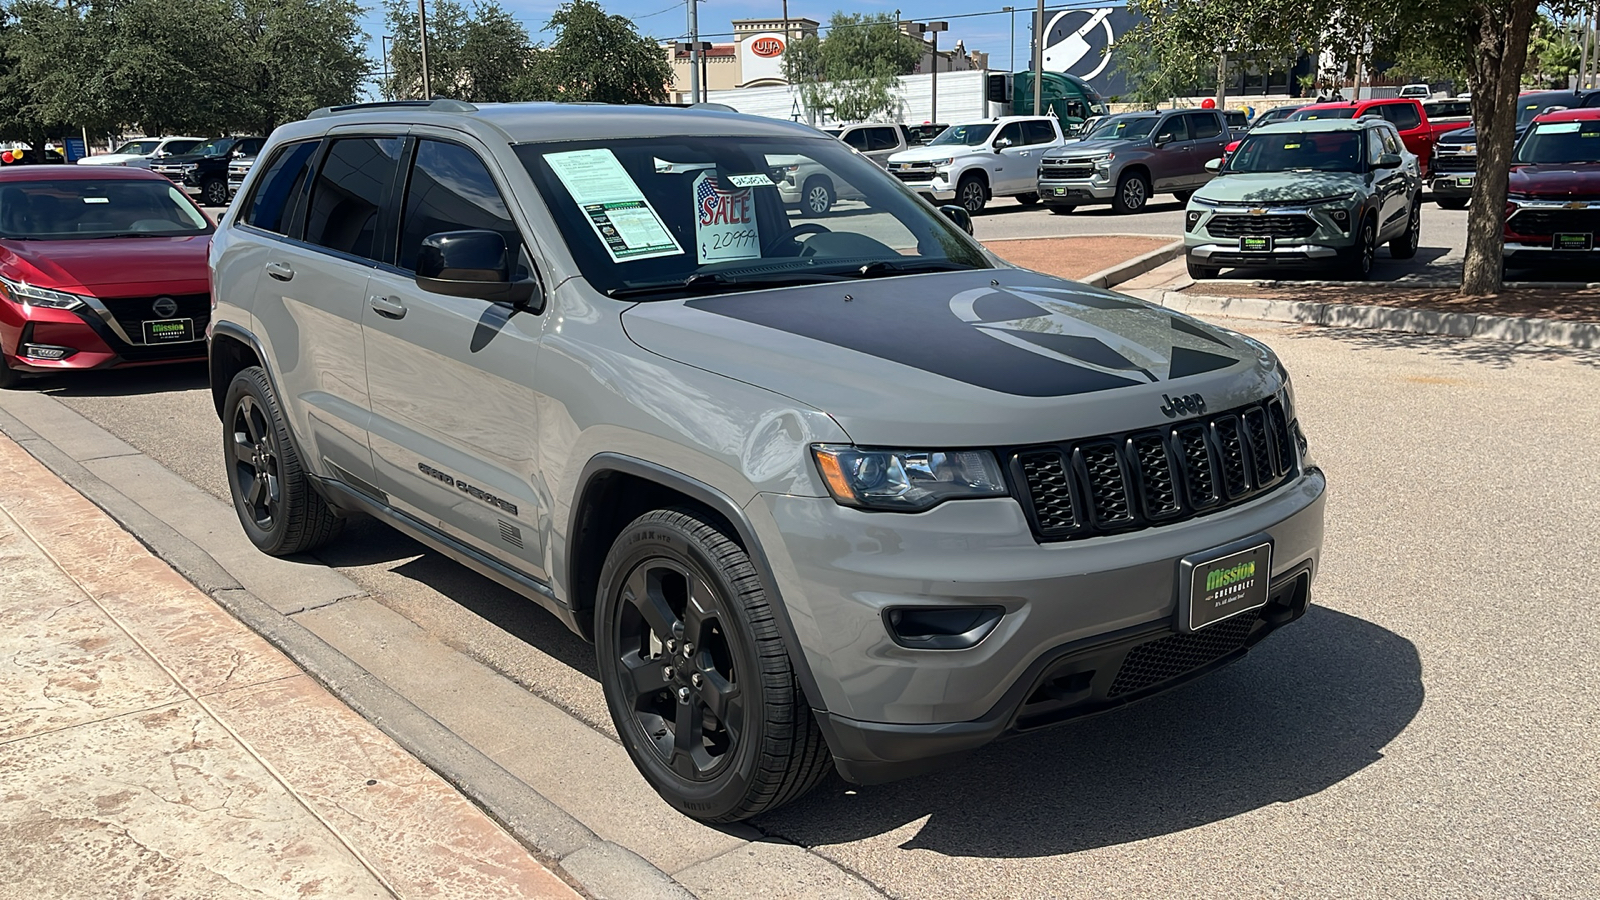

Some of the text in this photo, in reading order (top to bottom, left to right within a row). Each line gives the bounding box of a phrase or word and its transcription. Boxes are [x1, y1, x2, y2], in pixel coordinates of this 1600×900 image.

[757, 41, 780, 50] ULTA
[701, 195, 751, 227] SALE
[702, 243, 707, 259] $
[153, 323, 183, 333] Mission
[1159, 393, 1208, 419] Jeep
[417, 462, 519, 517] GRAND CHEROKEE
[1206, 560, 1256, 592] Mission
[1214, 579, 1255, 600] CHEVROLET
